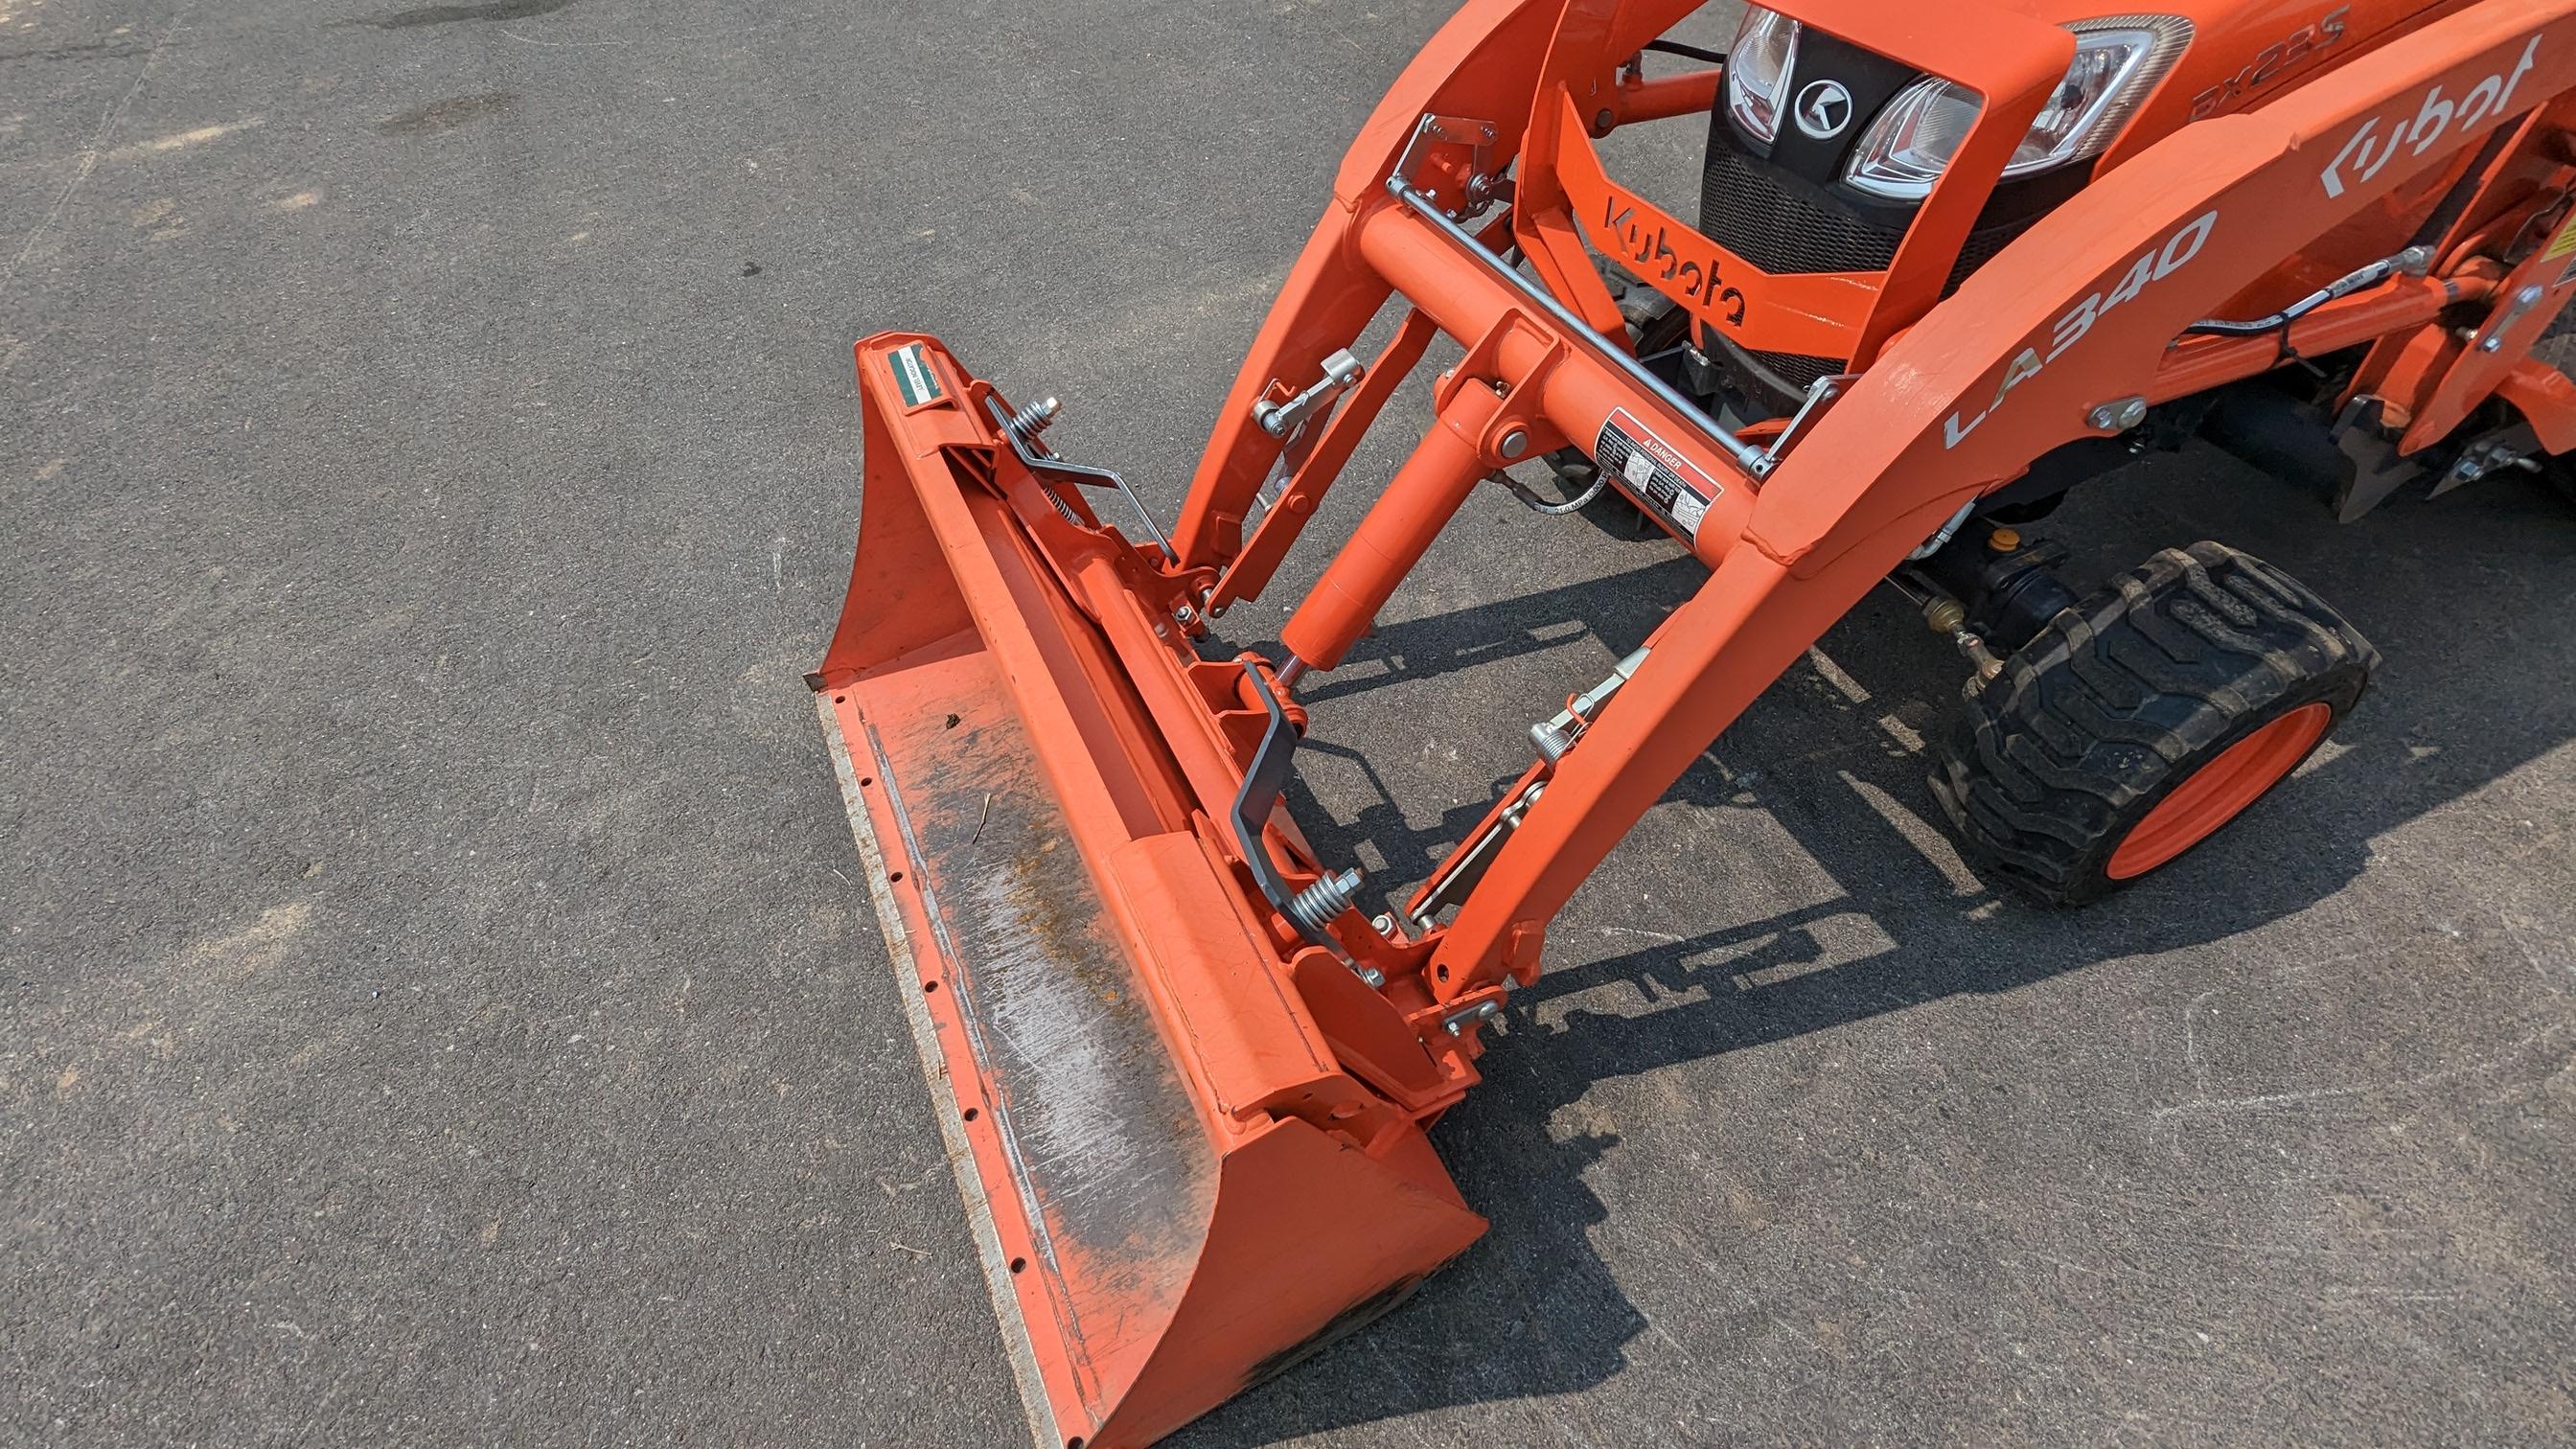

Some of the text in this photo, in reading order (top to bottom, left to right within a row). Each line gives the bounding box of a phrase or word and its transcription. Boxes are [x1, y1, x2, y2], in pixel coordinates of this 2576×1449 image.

[1604, 196, 1746, 328] Kubota
[1944, 210, 2218, 449] LA340
[1649, 441, 1683, 470] DANGER
[1572, 497, 1589, 510] MPa
